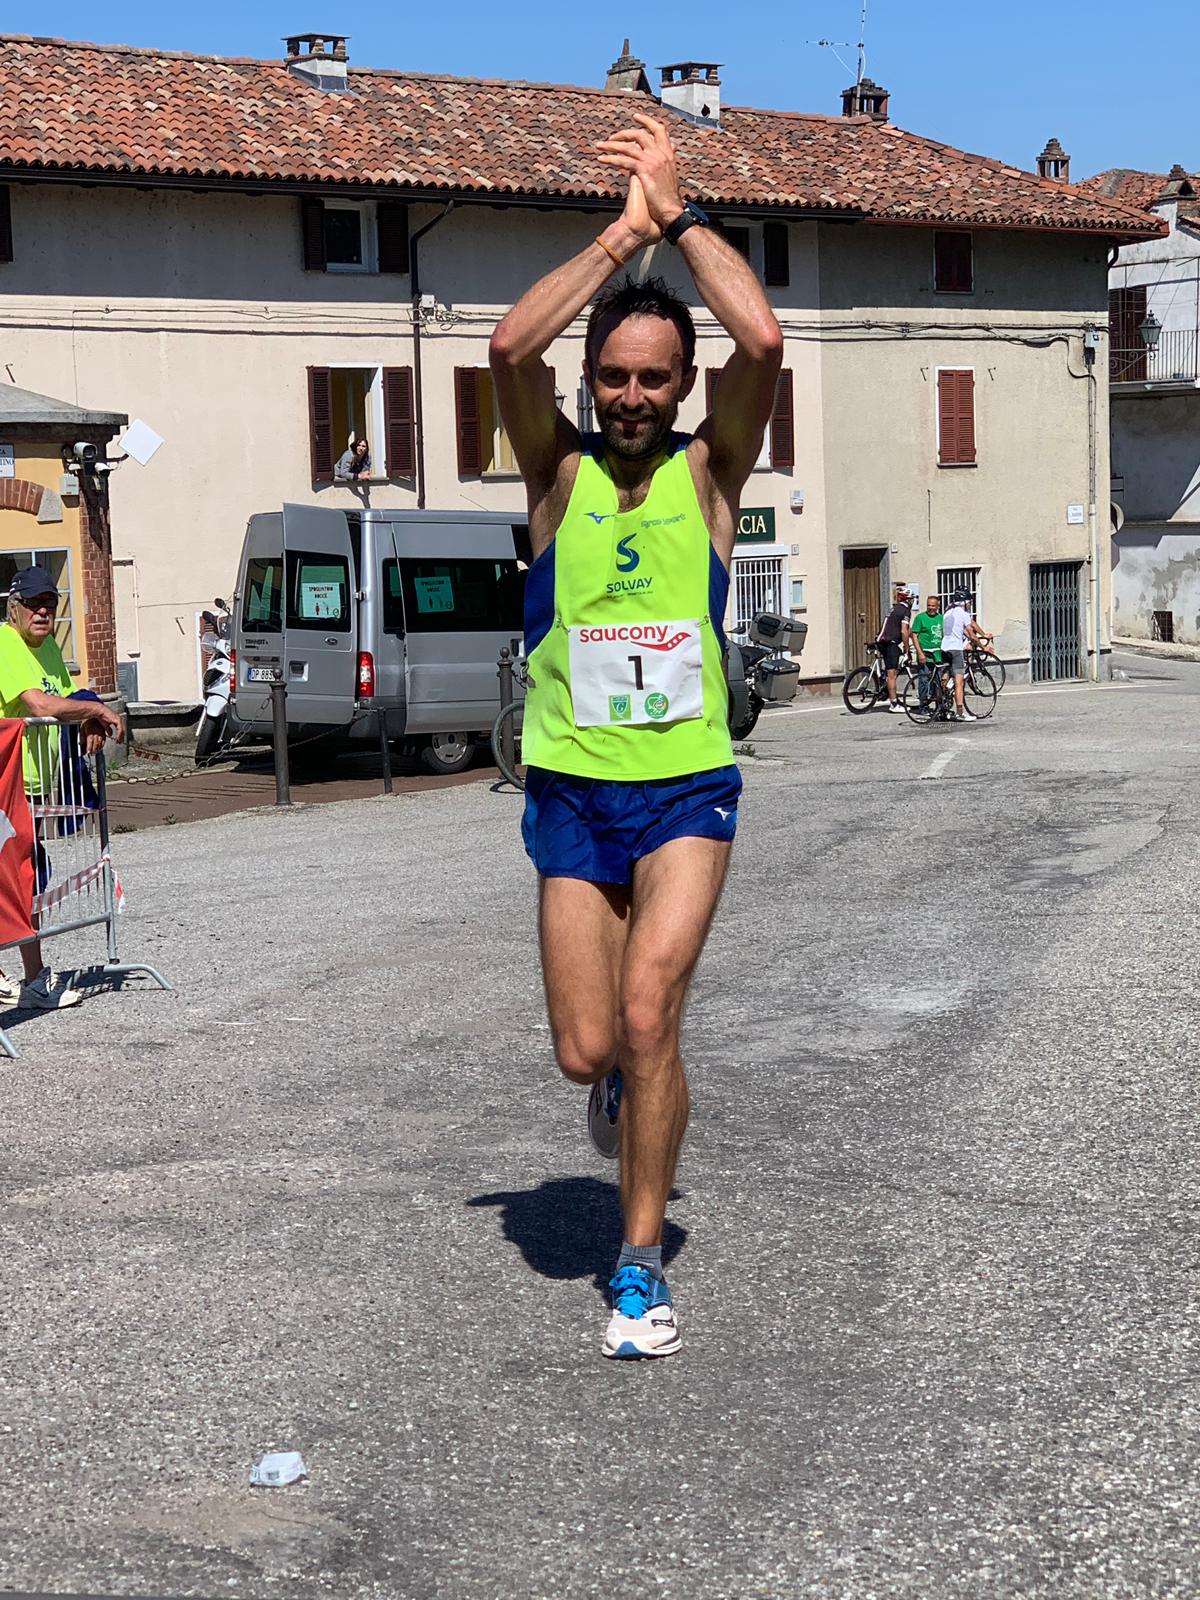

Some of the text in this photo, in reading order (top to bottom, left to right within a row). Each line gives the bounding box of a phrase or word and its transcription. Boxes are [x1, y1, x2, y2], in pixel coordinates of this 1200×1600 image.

[738, 515, 767, 534] CIA
[606, 577, 653, 594] SOLVAY
[580, 625, 668, 643] saucony
[627, 655, 644, 690] 1
